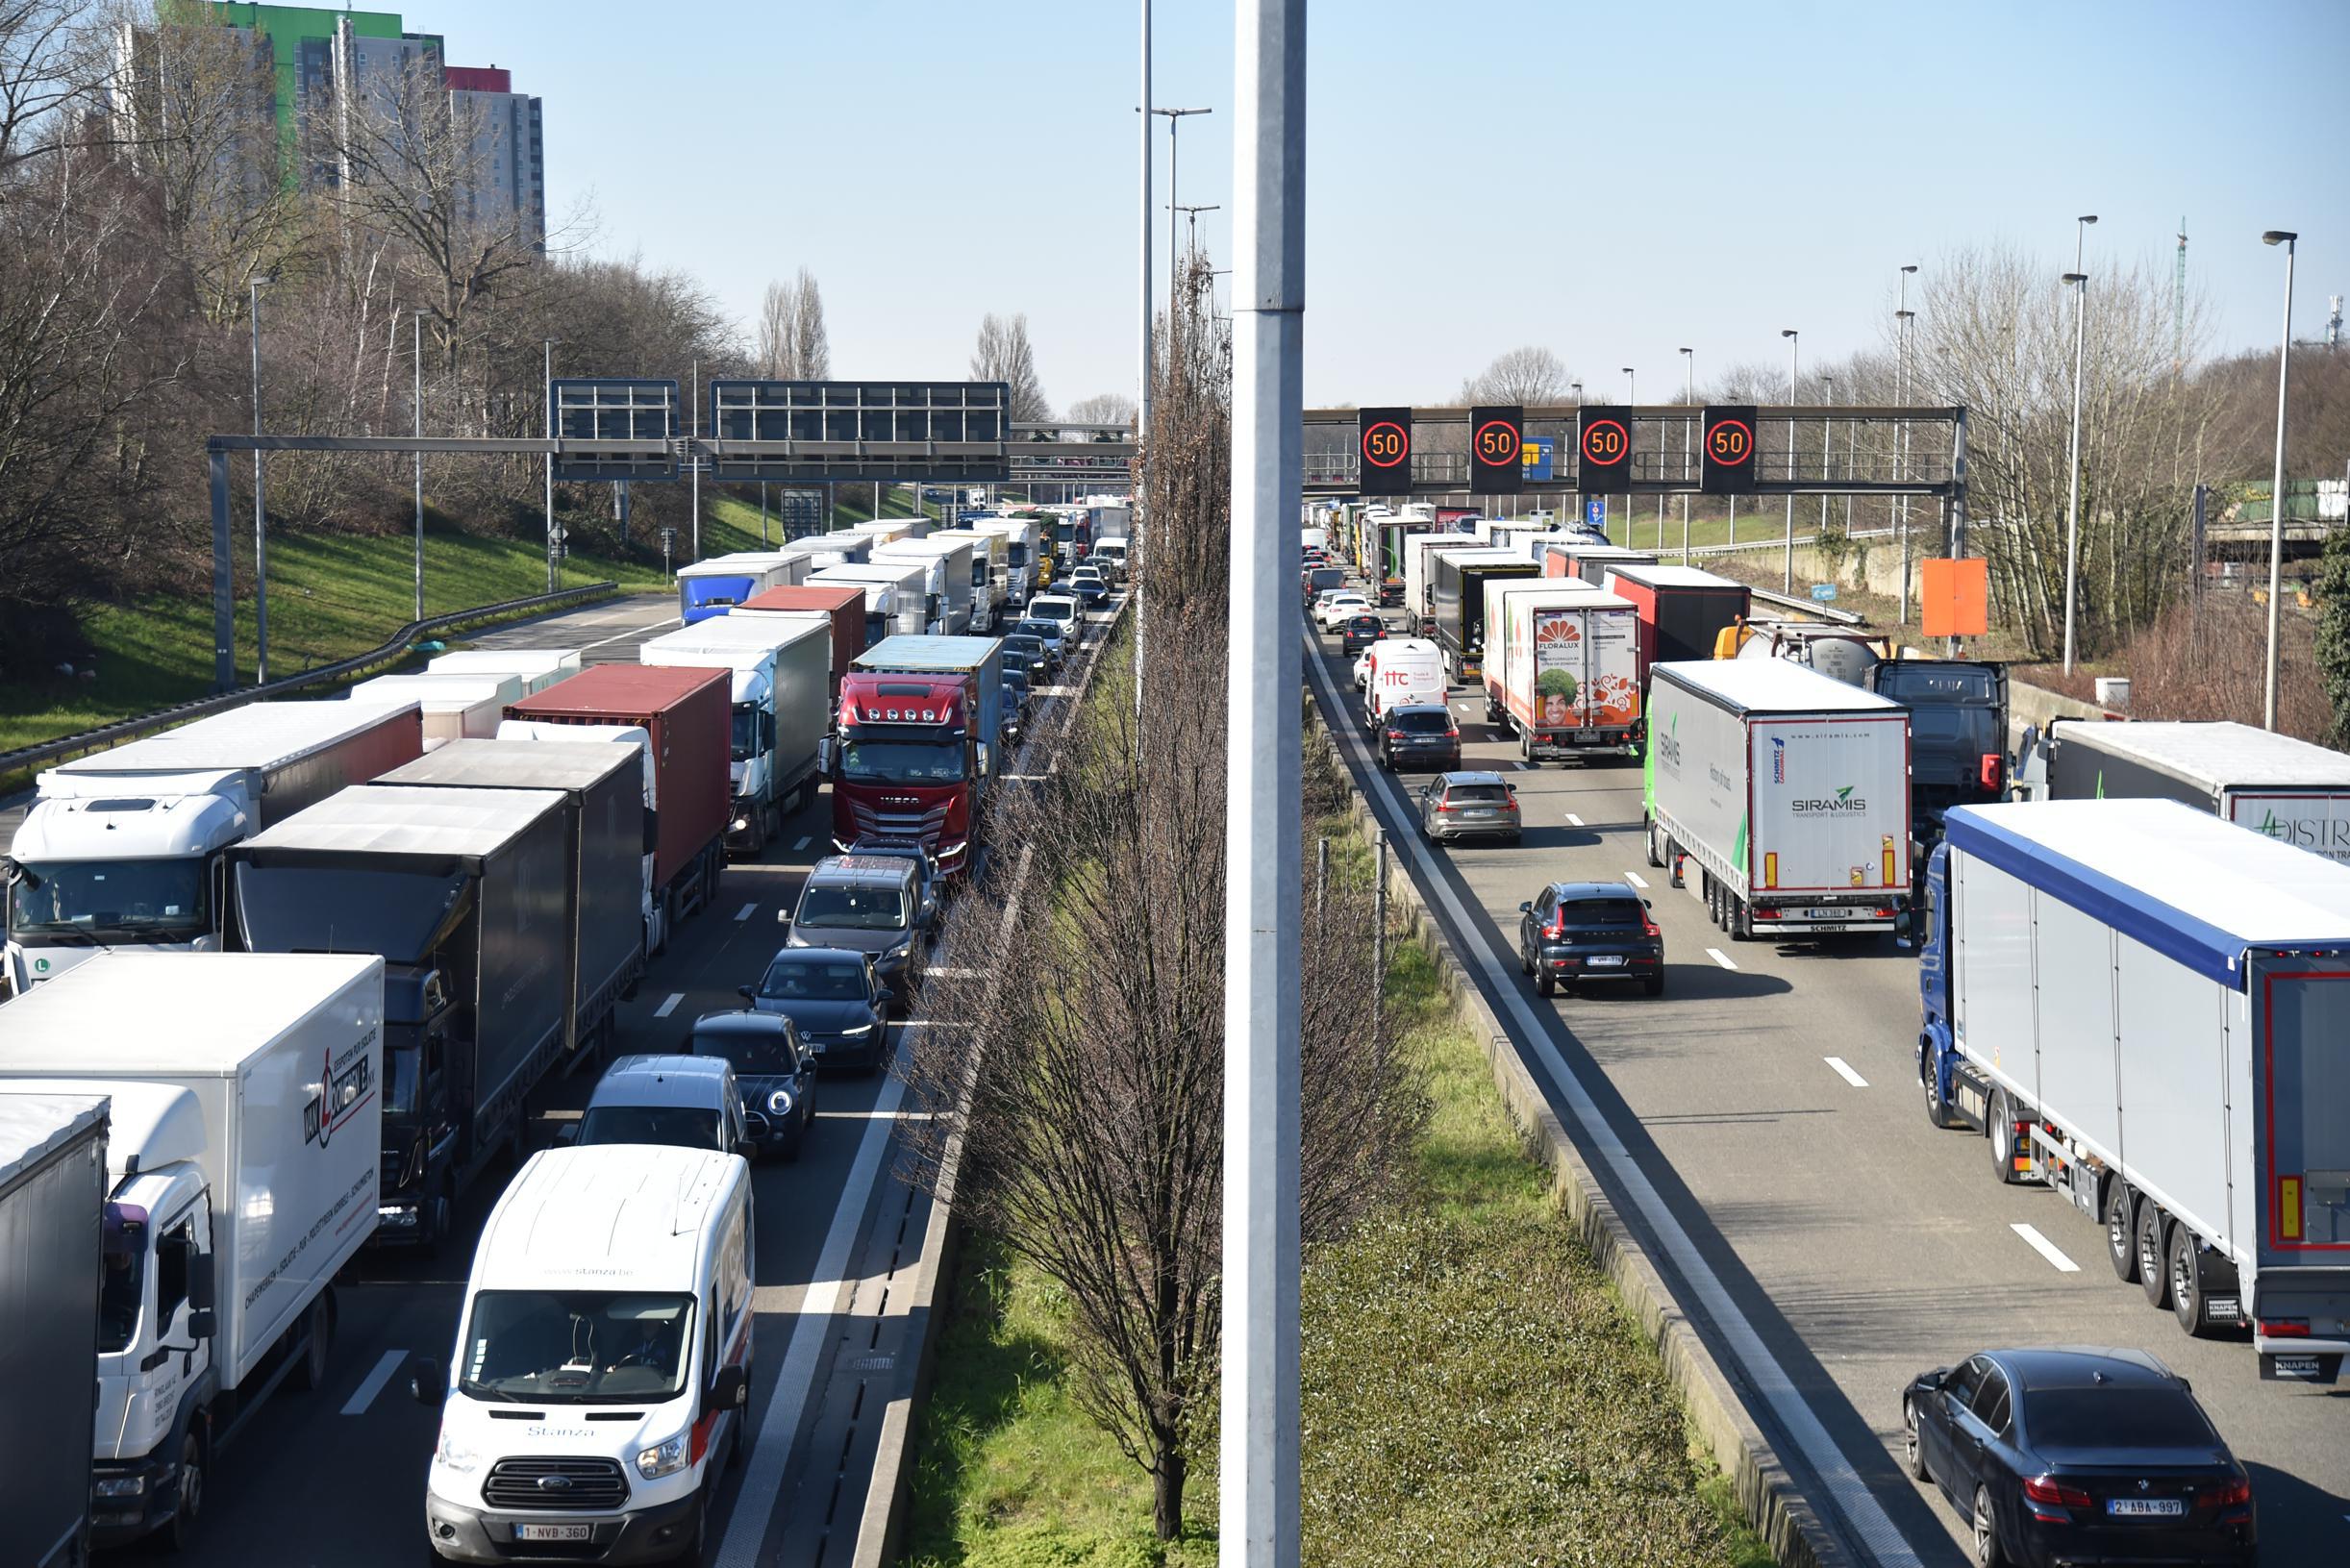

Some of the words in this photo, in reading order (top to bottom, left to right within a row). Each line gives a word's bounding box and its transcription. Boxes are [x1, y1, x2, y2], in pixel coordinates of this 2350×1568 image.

[1372, 434, 1399, 455] 50
[1484, 433, 1511, 454] 50
[1591, 432, 1618, 453] 50
[1715, 432, 1743, 454] 50
[1791, 799, 1866, 811] SIRAMIS
[38, 959, 46, 971] L
[305, 1099, 319, 1142] VAN
[2275, 1360, 2320, 1370] KNAPEN
[528, 1426, 595, 1437] Stanza
